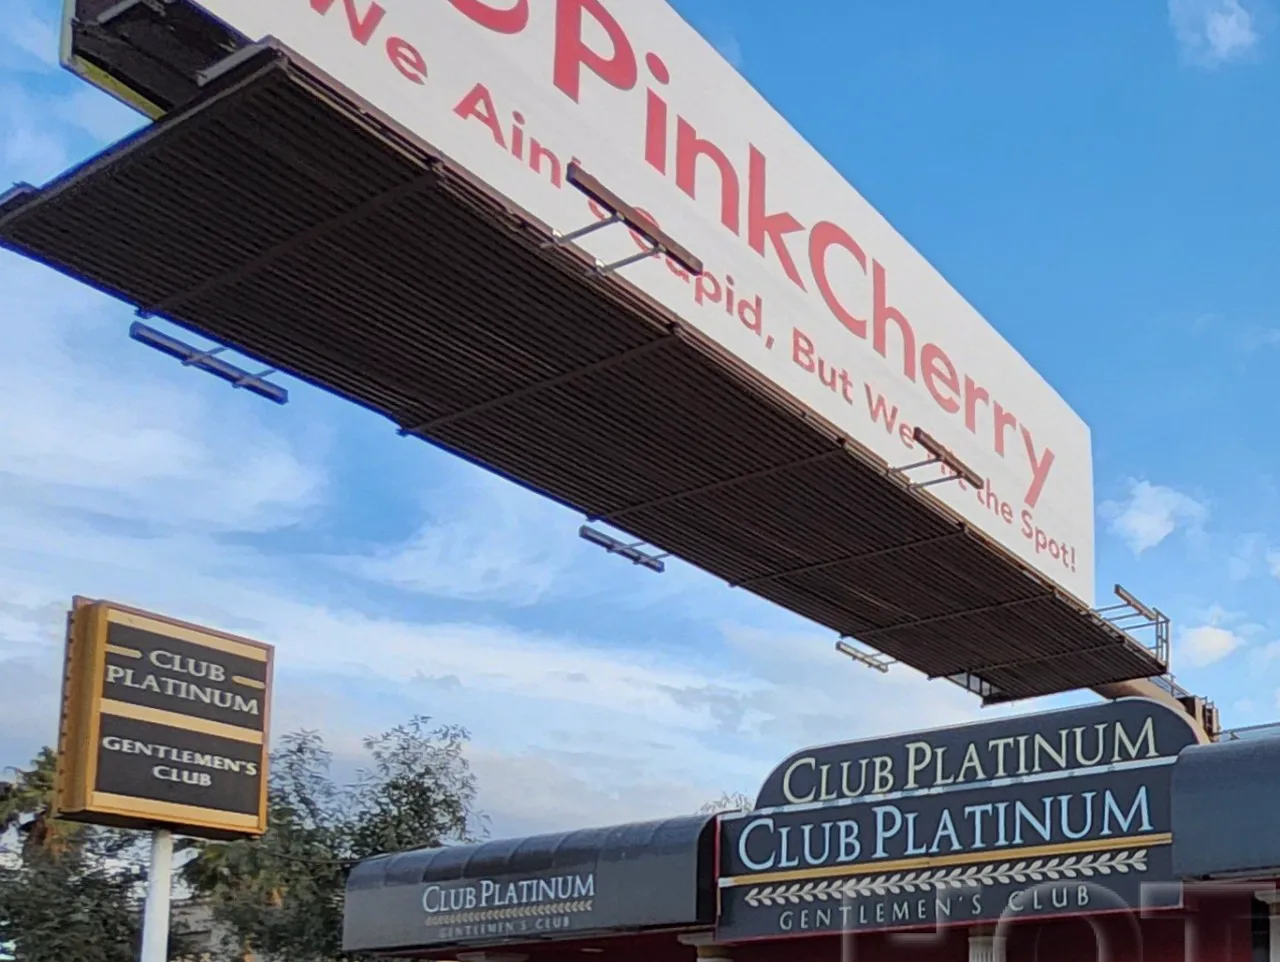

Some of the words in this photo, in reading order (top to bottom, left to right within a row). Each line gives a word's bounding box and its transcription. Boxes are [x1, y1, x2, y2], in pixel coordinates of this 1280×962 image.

[553, 0, 1055, 508] PinkCherry
[793, 326, 853, 405] But
[864, 382, 914, 449] We
[1021, 509, 1076, 572] Spot!
[149, 650, 226, 682] CLUB
[106, 665, 259, 715] PLATINUM
[102, 736, 258, 776] GENTLEMEN'S
[152, 766, 213, 787] CLUB
[783, 757, 894, 803] CLUB
[904, 717, 1160, 789] PLATINUM
[739, 818, 861, 870] CLUB
[871, 785, 1154, 859] PLATINUM
[422, 886, 476, 913] CLUB
[480, 874, 595, 907] PLATINUM
[779, 894, 982, 930] GENTLEMEN'S
[1008, 884, 1090, 912] CLUB
[438, 920, 527, 939] GENTLEMENS
[535, 916, 569, 930] CLUB
